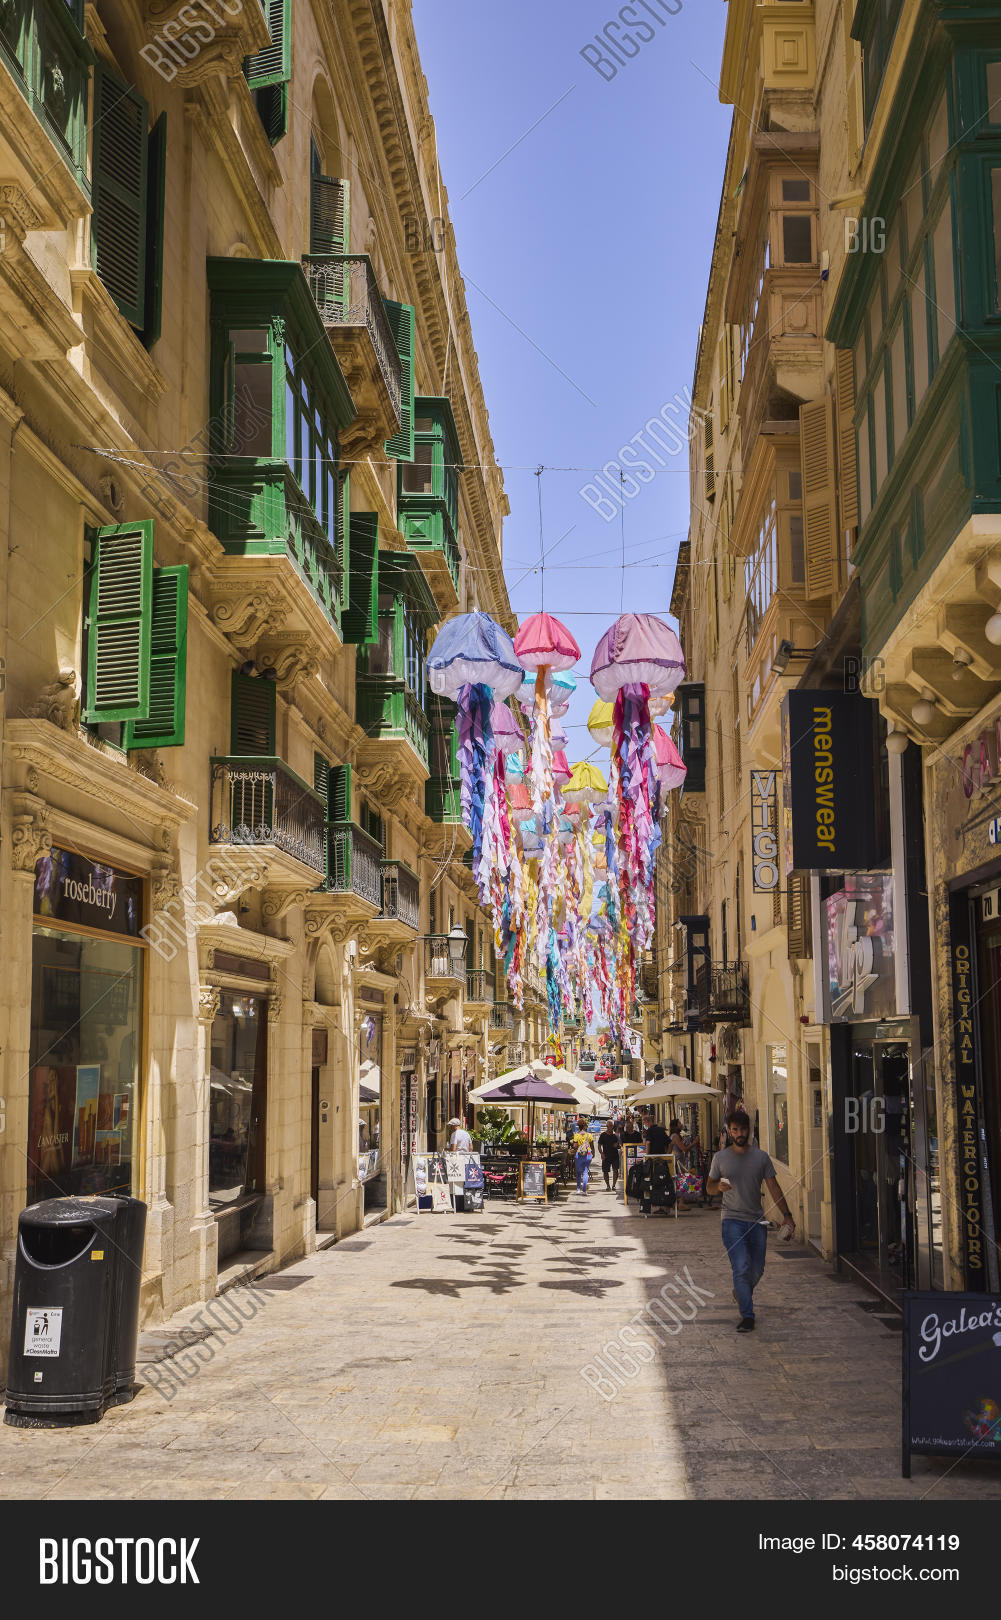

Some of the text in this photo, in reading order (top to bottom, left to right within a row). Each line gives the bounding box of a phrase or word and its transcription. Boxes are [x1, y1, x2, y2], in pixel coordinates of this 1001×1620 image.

[753, 772, 779, 889] VIGO
[813, 706, 836, 853] menswear
[63, 872, 117, 920] roseberry
[955, 945, 983, 1269] ORIGINAL WATERCOLOURS
